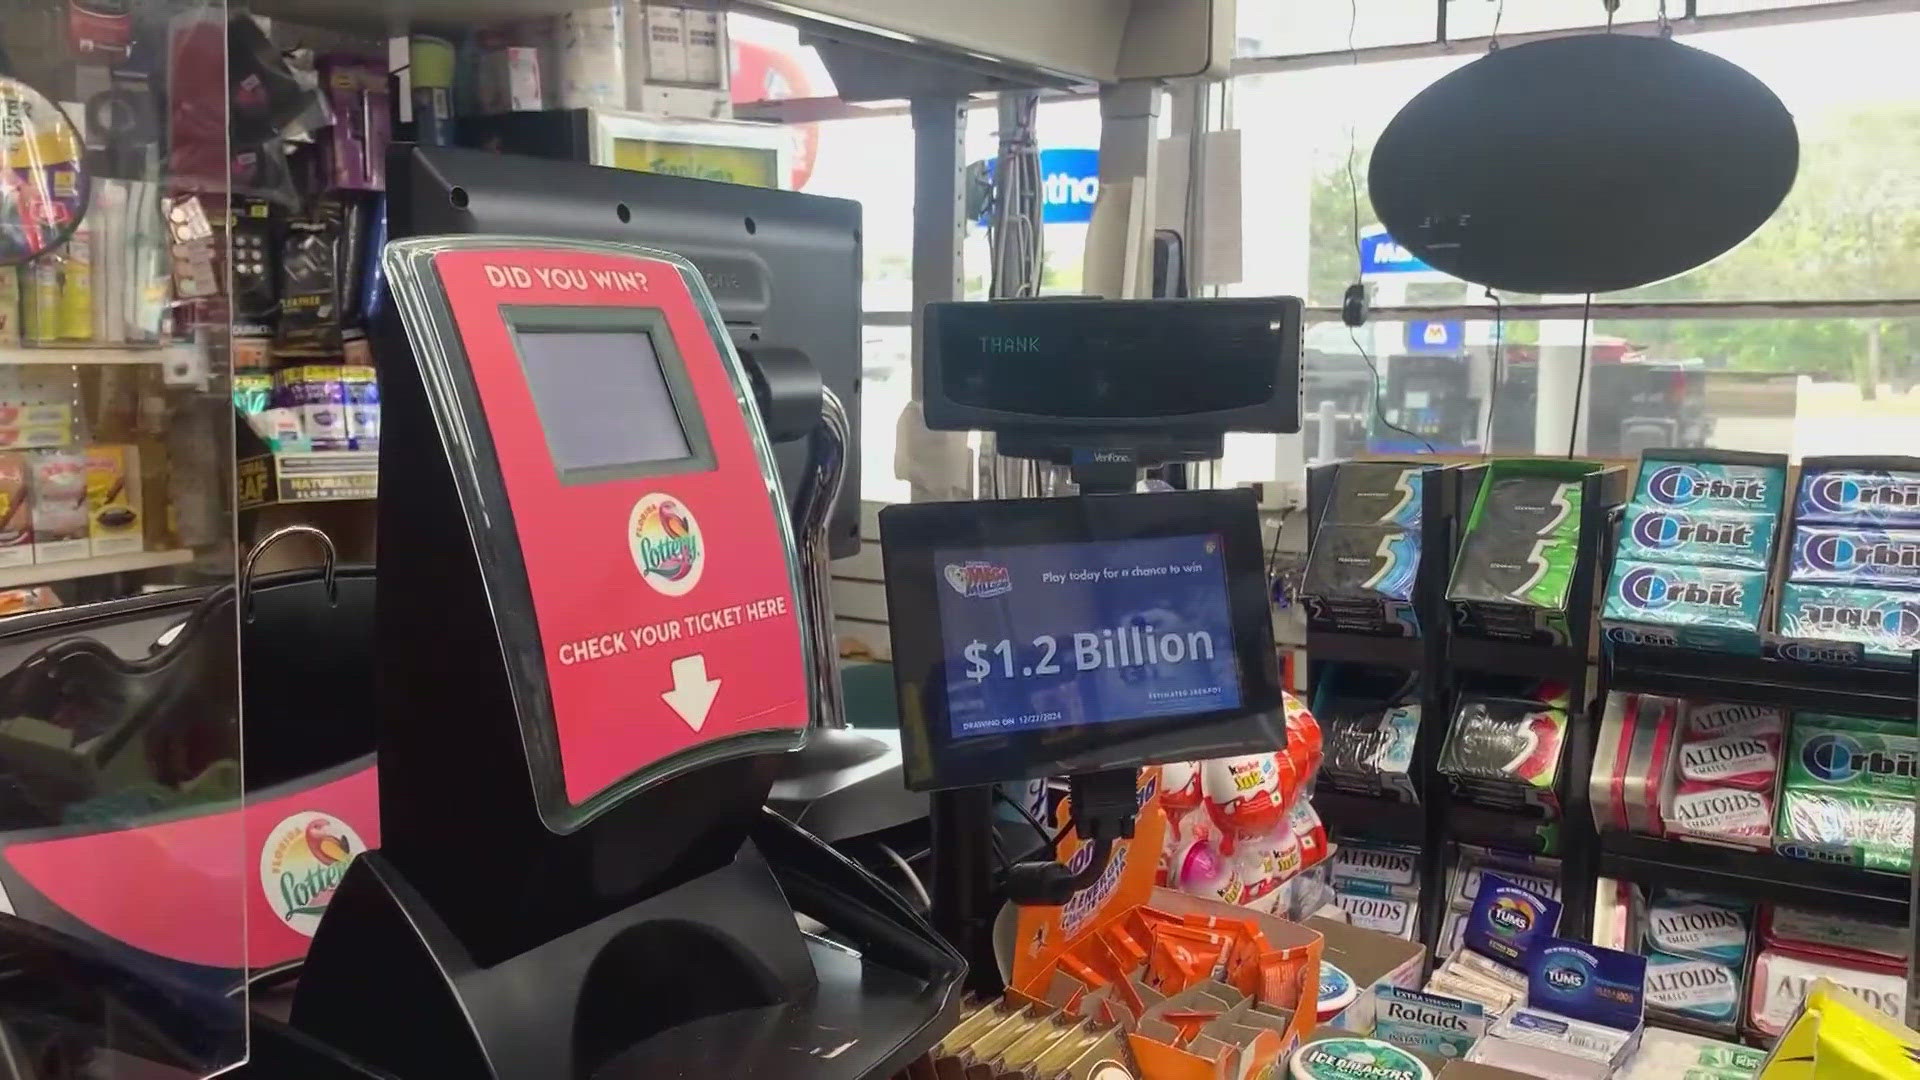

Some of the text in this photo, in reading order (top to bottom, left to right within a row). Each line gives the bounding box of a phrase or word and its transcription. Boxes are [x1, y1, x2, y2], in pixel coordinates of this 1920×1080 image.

[1042, 172, 1100, 205] tho
[485, 265, 648, 293] DID YOU WIN?
[978, 336, 1041, 353] THANK
[1647, 464, 1767, 508] Orbit
[1809, 474, 1920, 514] Orbi
[1632, 509, 1754, 551] Orbit
[641, 534, 700, 579] Lottery
[1803, 531, 1920, 573] Orbi
[1042, 561, 1203, 584] Play today for a chance to win
[1619, 566, 1745, 612] Orbit
[558, 597, 788, 665] CHECK YOUR TICKET HERE
[964, 624, 1214, 683] $1.2 Billion
[962, 719, 1000, 731] DRAWING
[1002, 718, 1015, 728] ON
[1695, 706, 1777, 730] ALTOIDS
[1684, 740, 1767, 769] ALTOIDS
[1678, 793, 1762, 822] ALTOIDS
[1339, 850, 1411, 873] ALTOIDS
[1496, 909, 1527, 929] TUMS
[1658, 911, 1738, 935] ALTOIDS
[1549, 971, 1581, 986] TUMS
[1388, 1003, 1468, 1031] Rolaids
[1308, 1051, 1337, 1067] ICE
